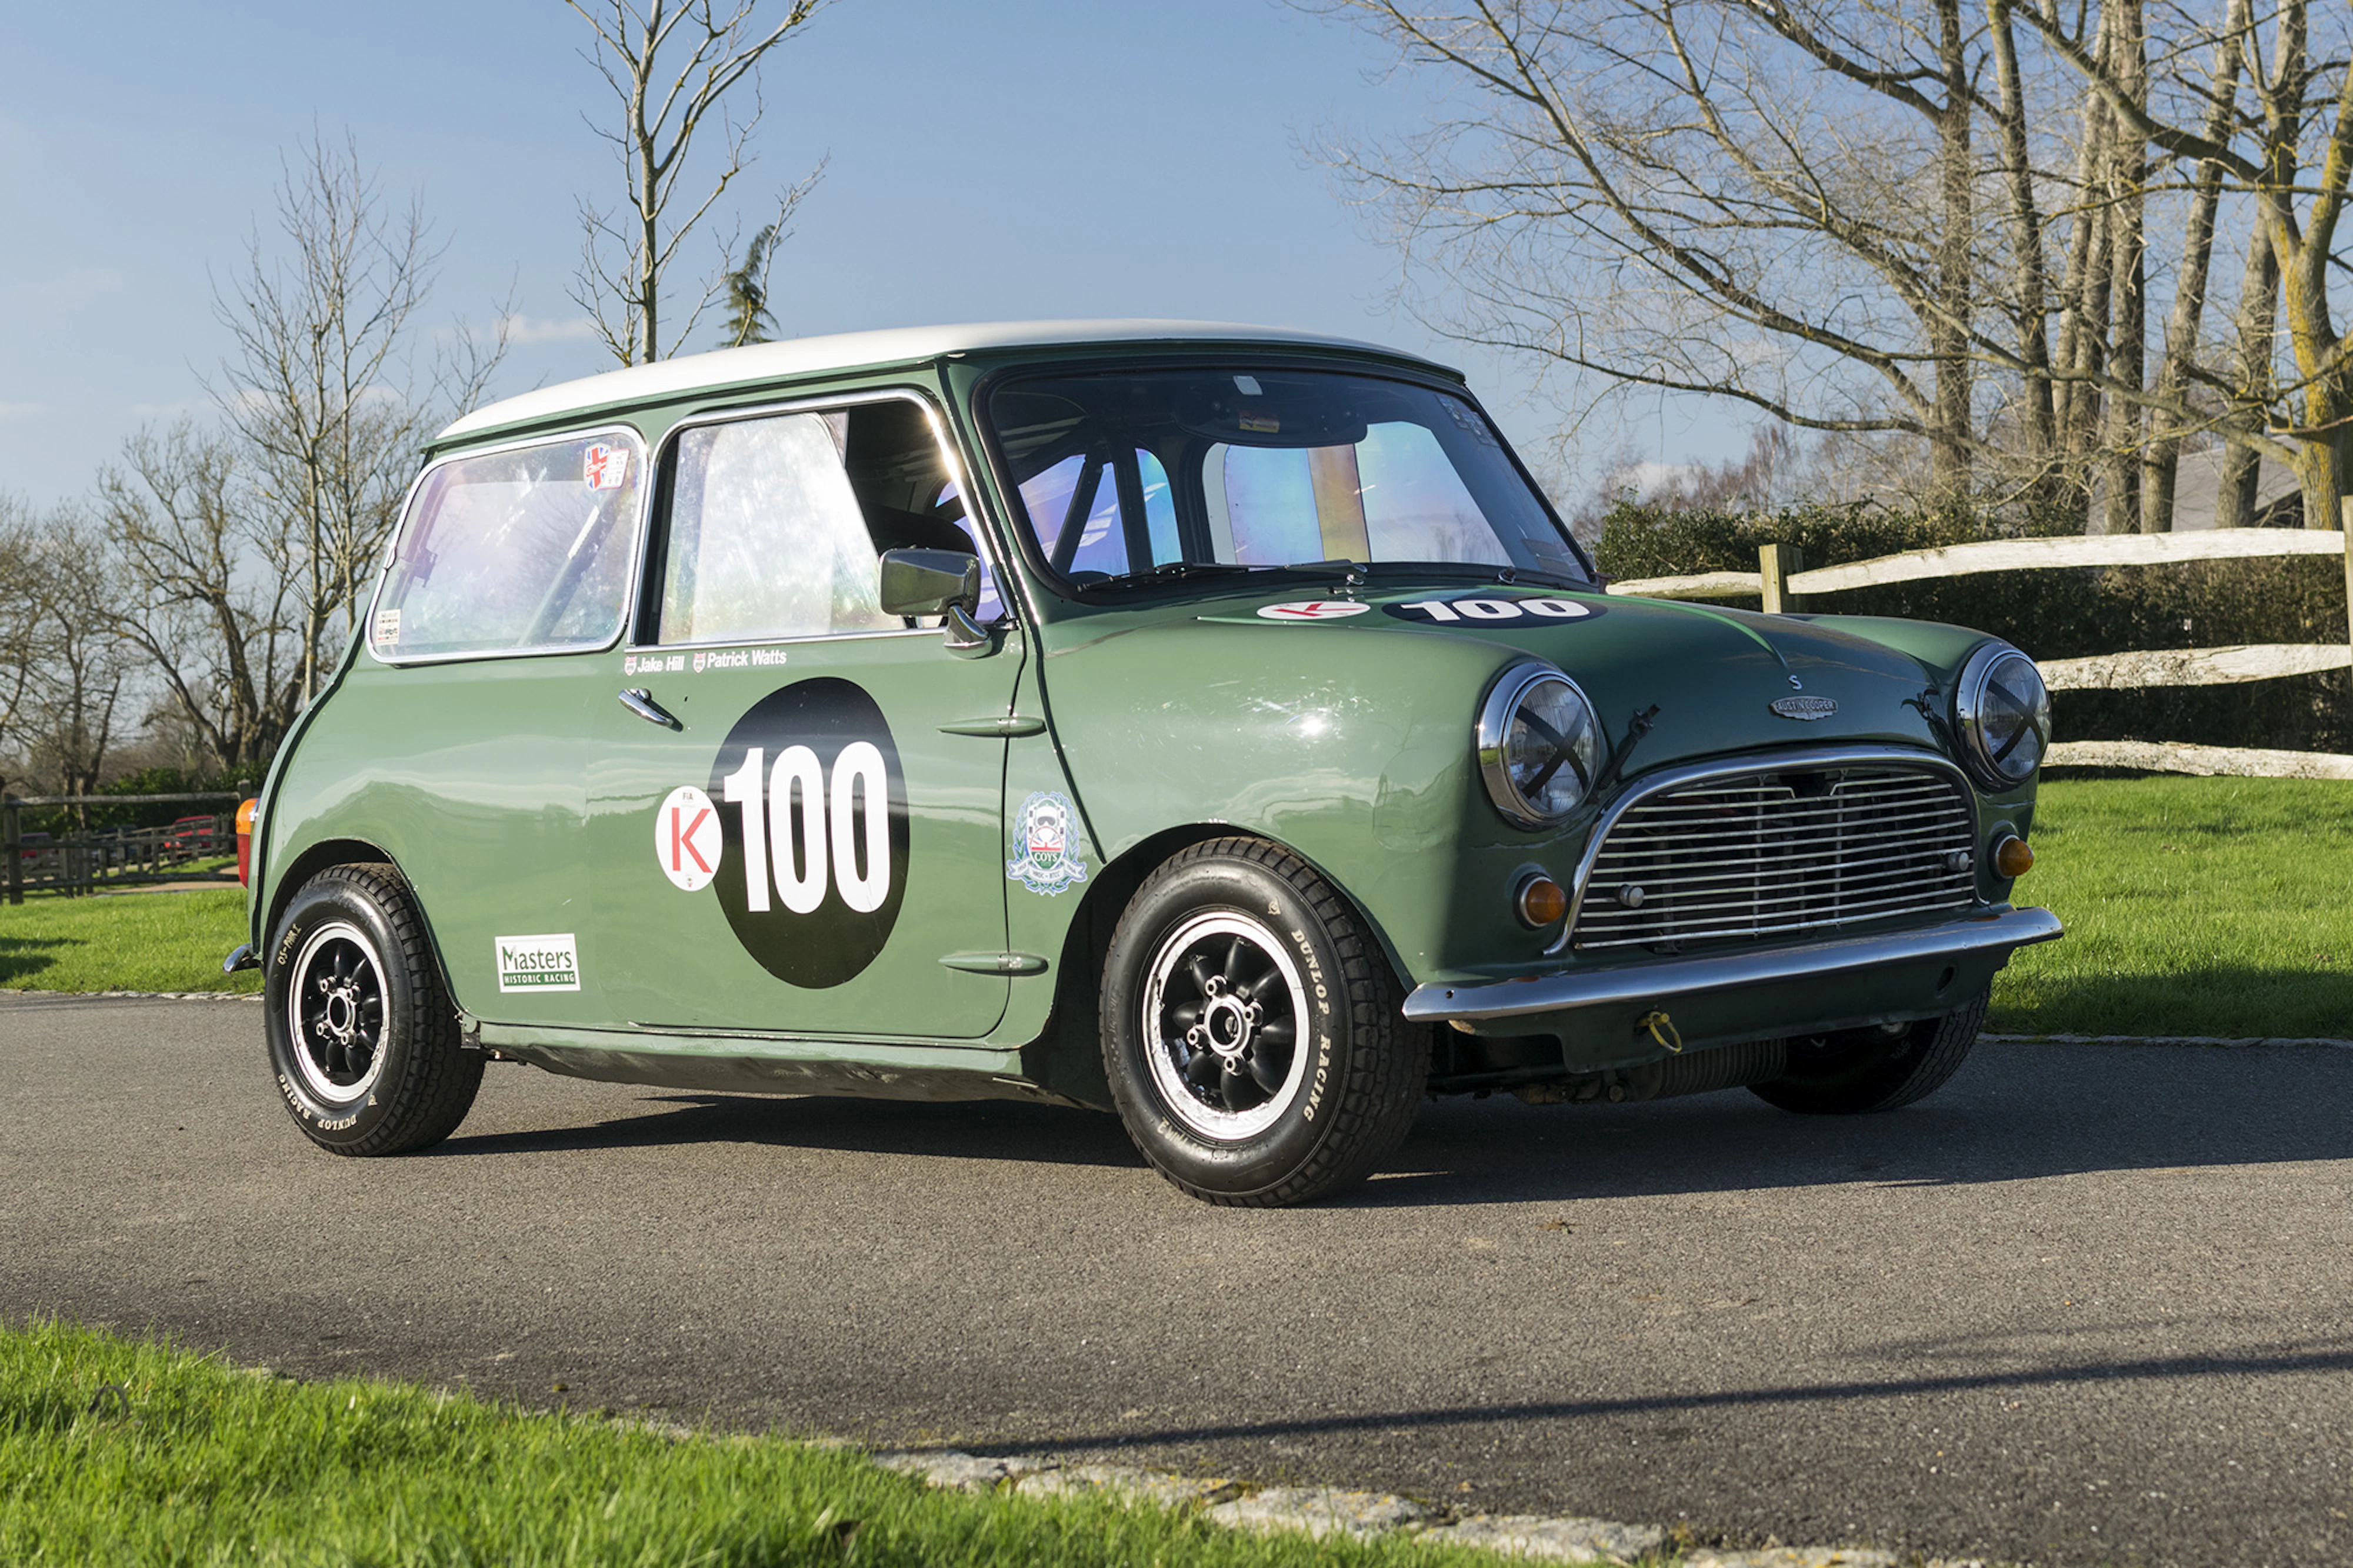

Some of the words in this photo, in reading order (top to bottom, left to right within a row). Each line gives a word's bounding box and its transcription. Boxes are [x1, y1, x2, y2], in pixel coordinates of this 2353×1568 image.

[1401, 599, 1590, 622] 100
[637, 657, 663, 673] Jake
[665, 655, 685, 672] Hill
[706, 650, 749, 669] Patrick
[751, 649, 787, 666] Watts
[1788, 675, 1802, 690] S
[724, 741, 890, 914] 100
[671, 807, 713, 873] K
[1034, 852, 1058, 862] COYS
[502, 945, 572, 970] Masters
[504, 973, 541, 984] HISTORIC
[544, 973, 575, 983] RACING
[1291, 929, 1330, 1015] DUNLOP
[1302, 1033, 1332, 1122] RACING
[278, 1074, 311, 1120] RACING
[318, 1113, 357, 1130] DUNLOP
